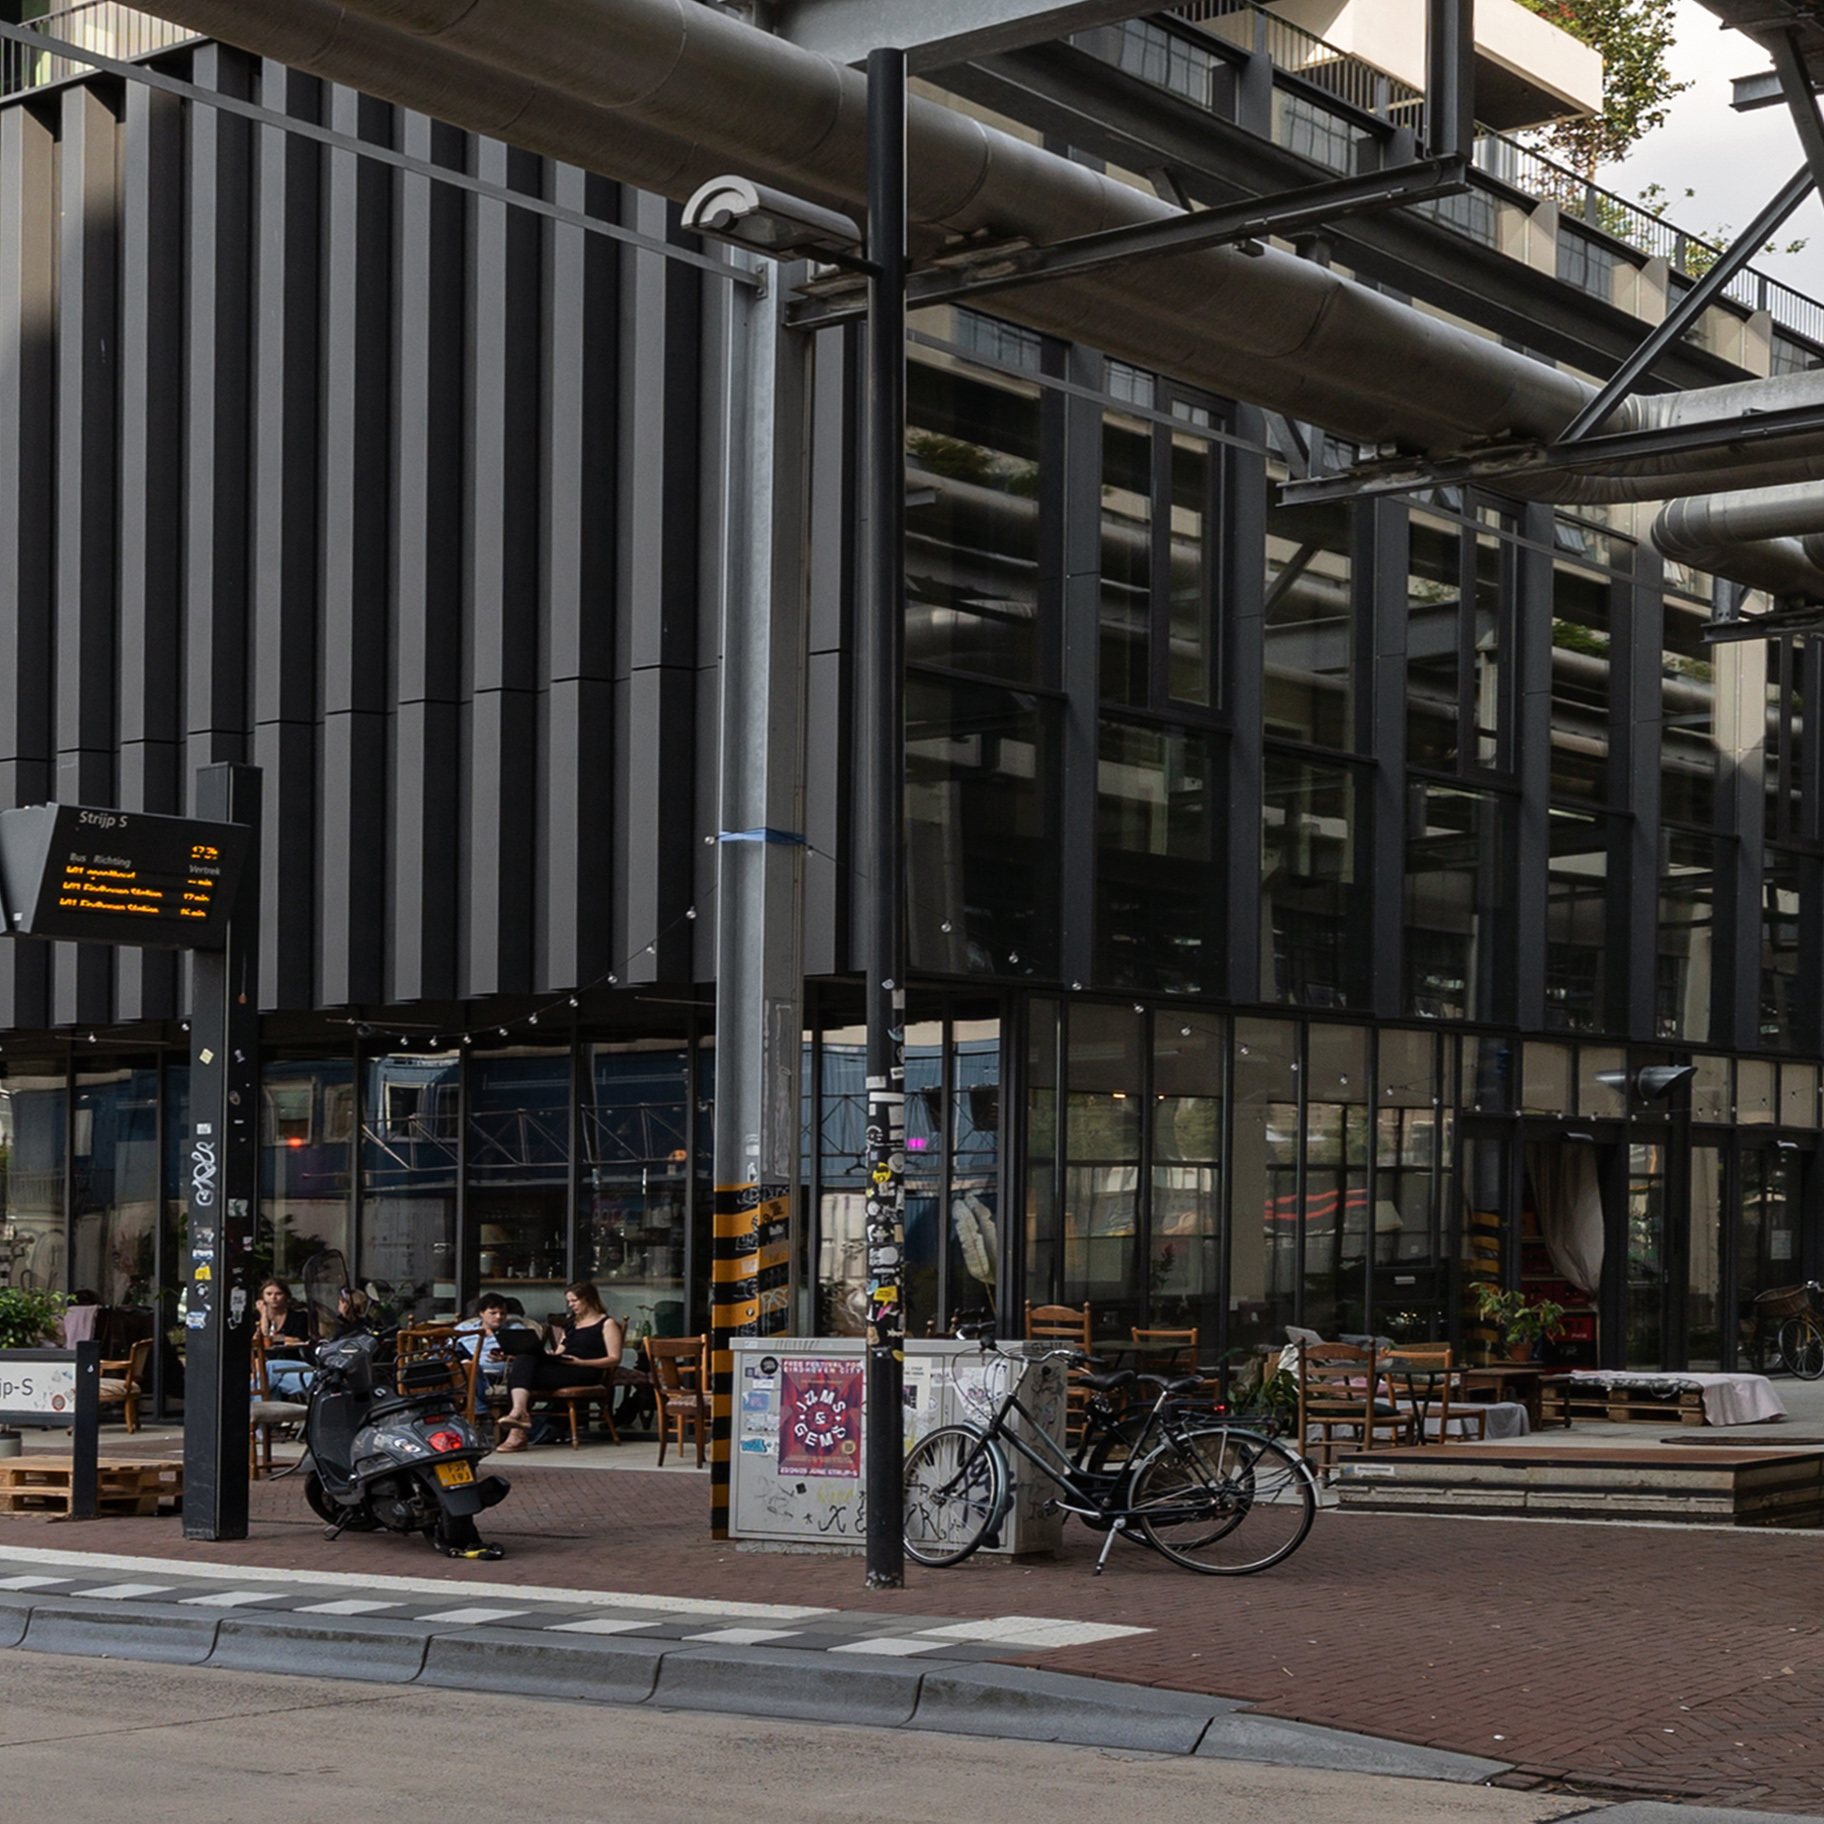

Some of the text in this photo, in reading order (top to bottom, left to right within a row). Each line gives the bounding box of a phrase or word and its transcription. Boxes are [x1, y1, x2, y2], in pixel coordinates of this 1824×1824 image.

[79, 810, 128, 829] Strijp S
[69, 852, 132, 868] Bus Richting
[189, 864, 221, 876] Vertrek
[815, 1411, 827, 1425] &
